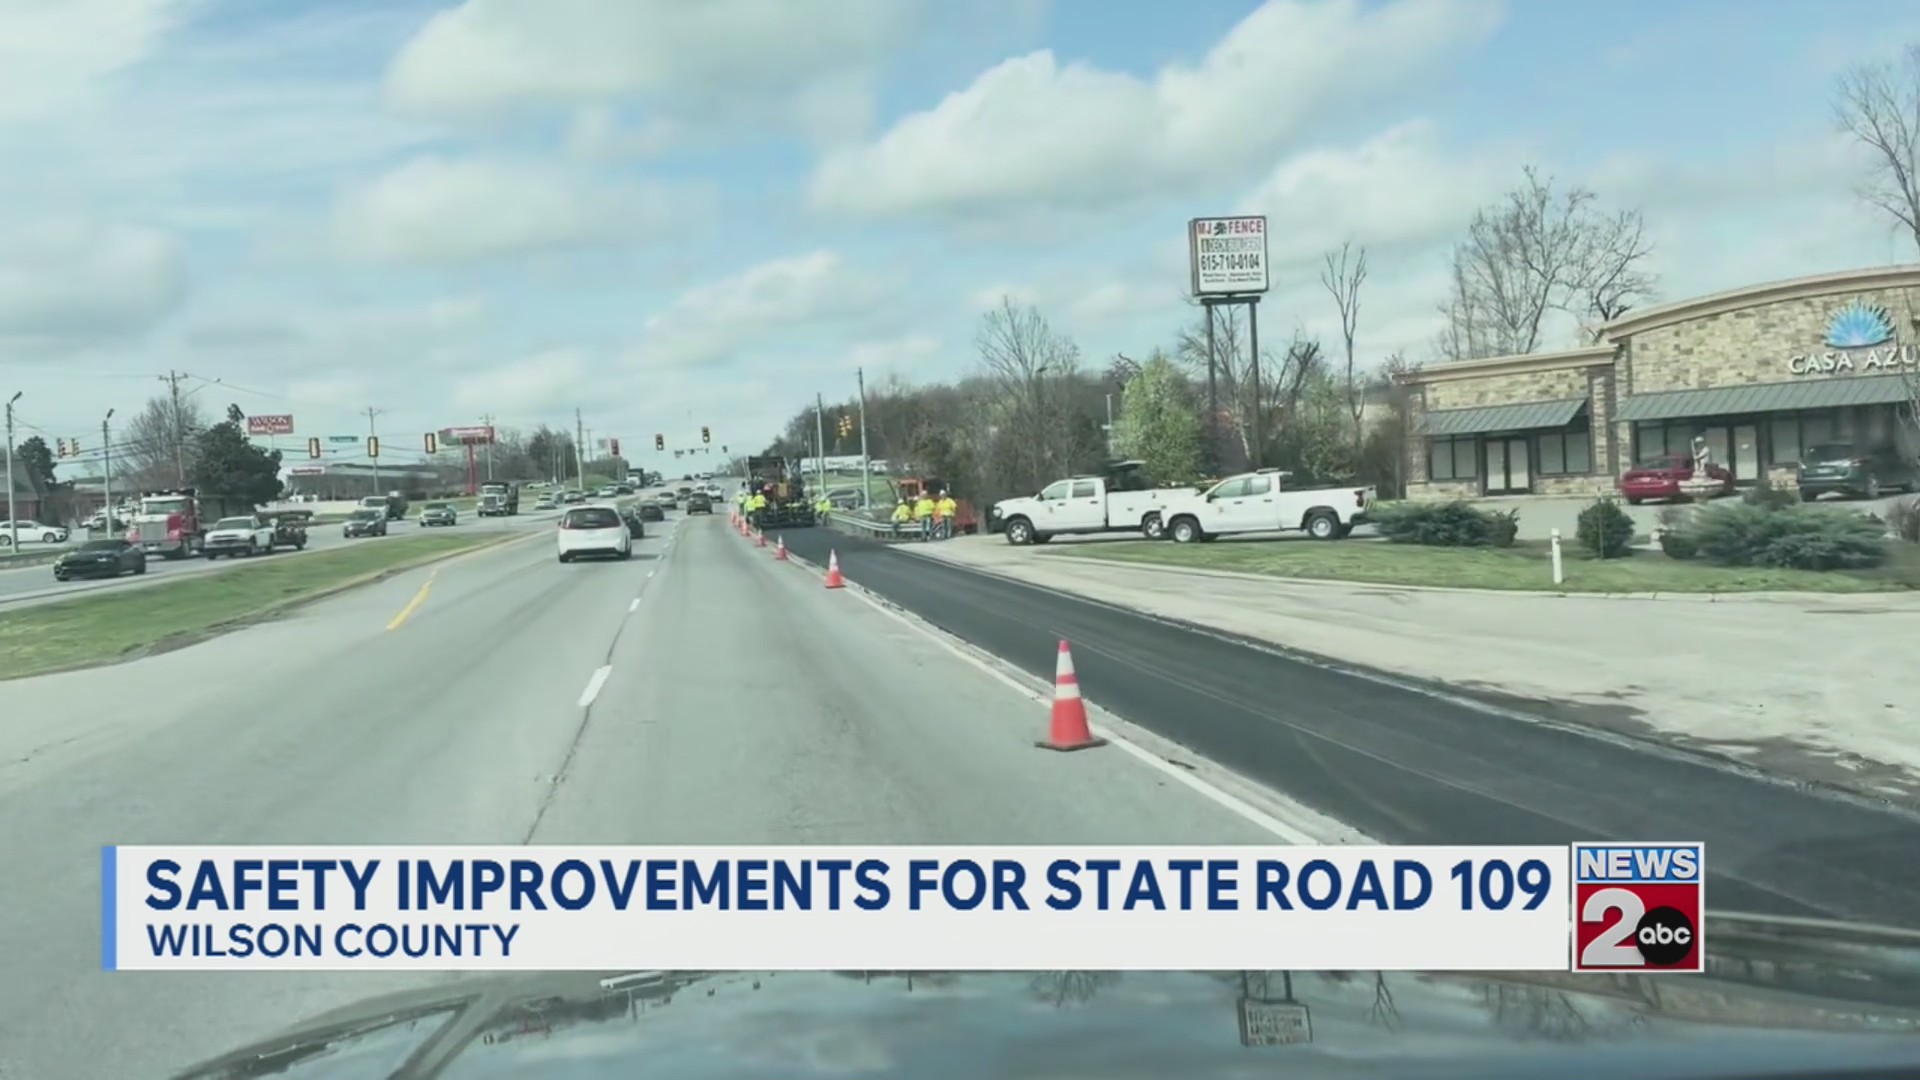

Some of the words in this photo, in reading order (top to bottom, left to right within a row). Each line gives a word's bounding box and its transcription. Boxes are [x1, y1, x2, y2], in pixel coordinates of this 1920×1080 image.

[1197, 222, 1212, 234] MJ
[1228, 220, 1262, 234] FENCE
[1200, 253, 1260, 271] 615-710-0104
[1790, 351, 1853, 374] CASA
[250, 416, 288, 426] WILSON
